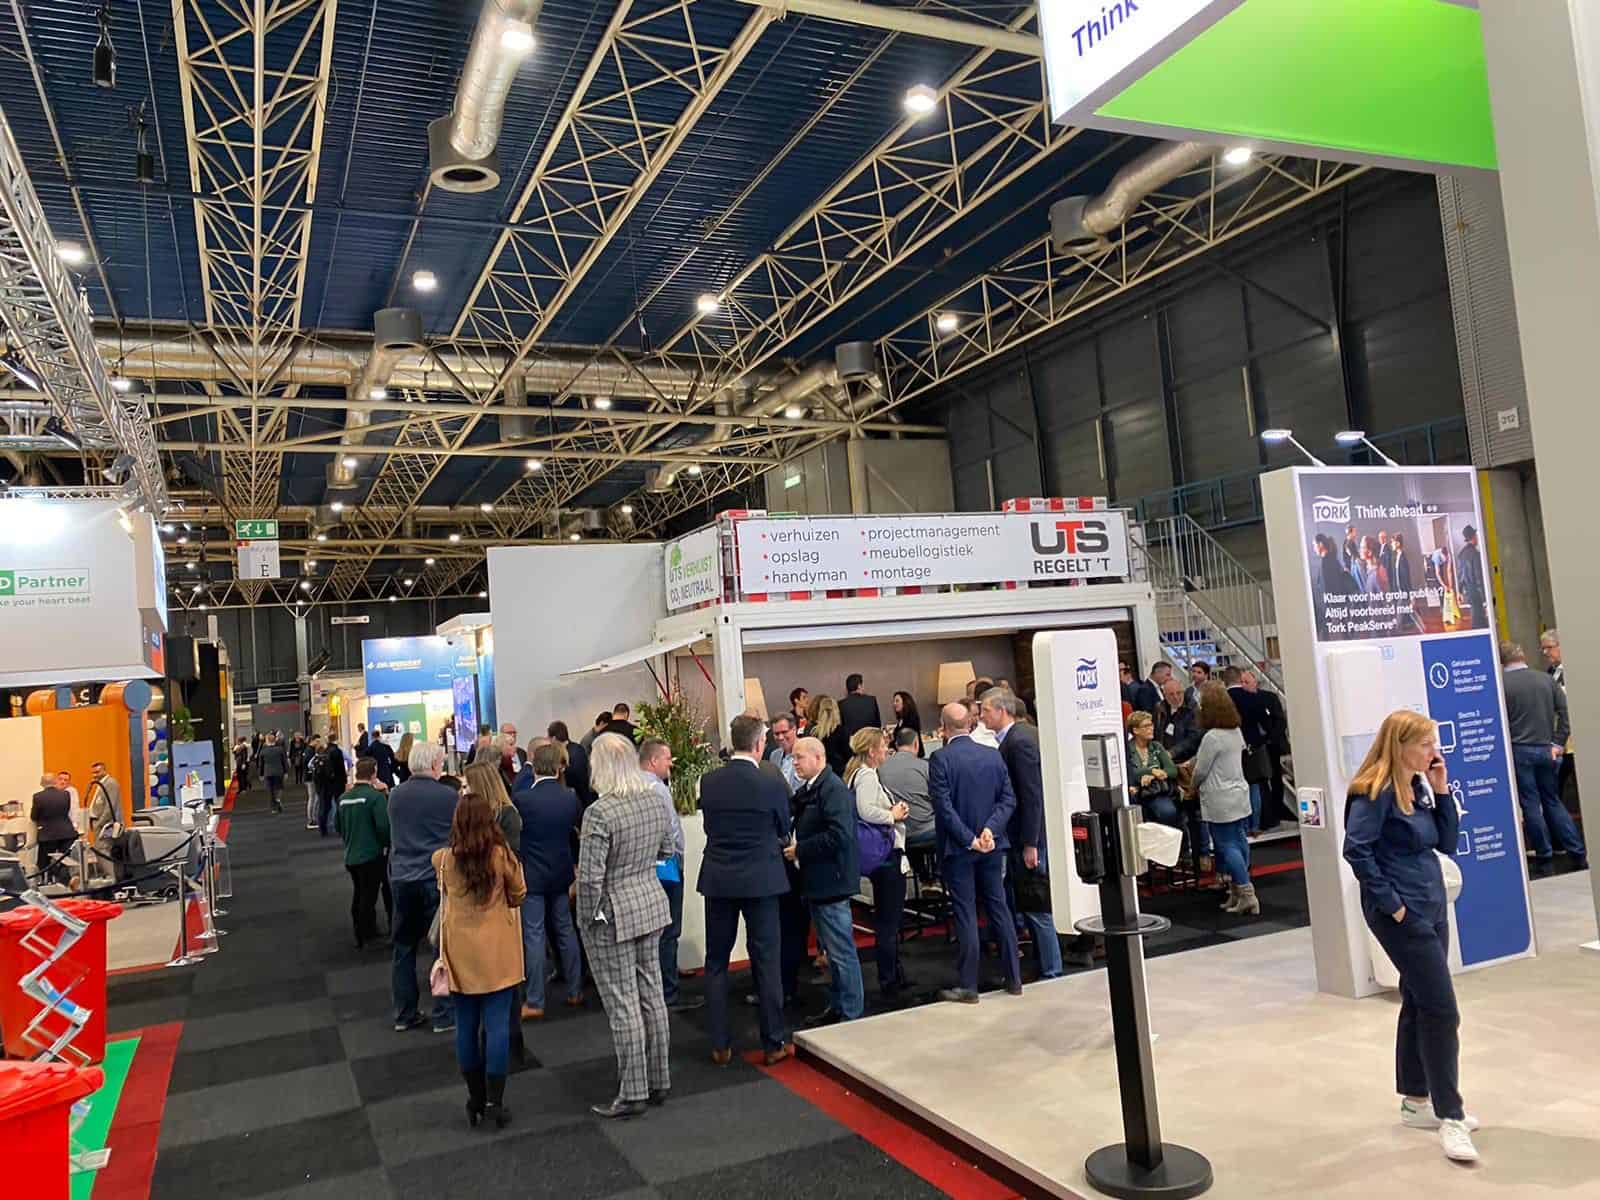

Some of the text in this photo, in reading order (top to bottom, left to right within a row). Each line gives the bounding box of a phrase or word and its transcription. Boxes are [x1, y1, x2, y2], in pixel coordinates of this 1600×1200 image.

[1313, 504, 1350, 520] TORK
[1354, 504, 1387, 519] Think
[770, 528, 840, 543] verhuizen
[868, 524, 1001, 541] projectmanagement
[1030, 520, 1110, 555] UTS
[771, 549, 820, 565] opslag
[869, 544, 974, 559] meubellogistiek
[871, 566, 932, 580] montage
[1034, 559, 1091, 574] REGELT
[18, 575, 86, 588] Partner
[772, 569, 848, 585] handyman
[13, 600, 36, 608] your
[39, 597, 65, 605] heart
[1349, 593, 1368, 602] voor
[1370, 591, 1384, 601] het
[1385, 590, 1408, 602] grote
[1325, 607, 1348, 620] Altijd
[1350, 604, 1396, 618] voorbereid
[1327, 621, 1347, 634] Tork
